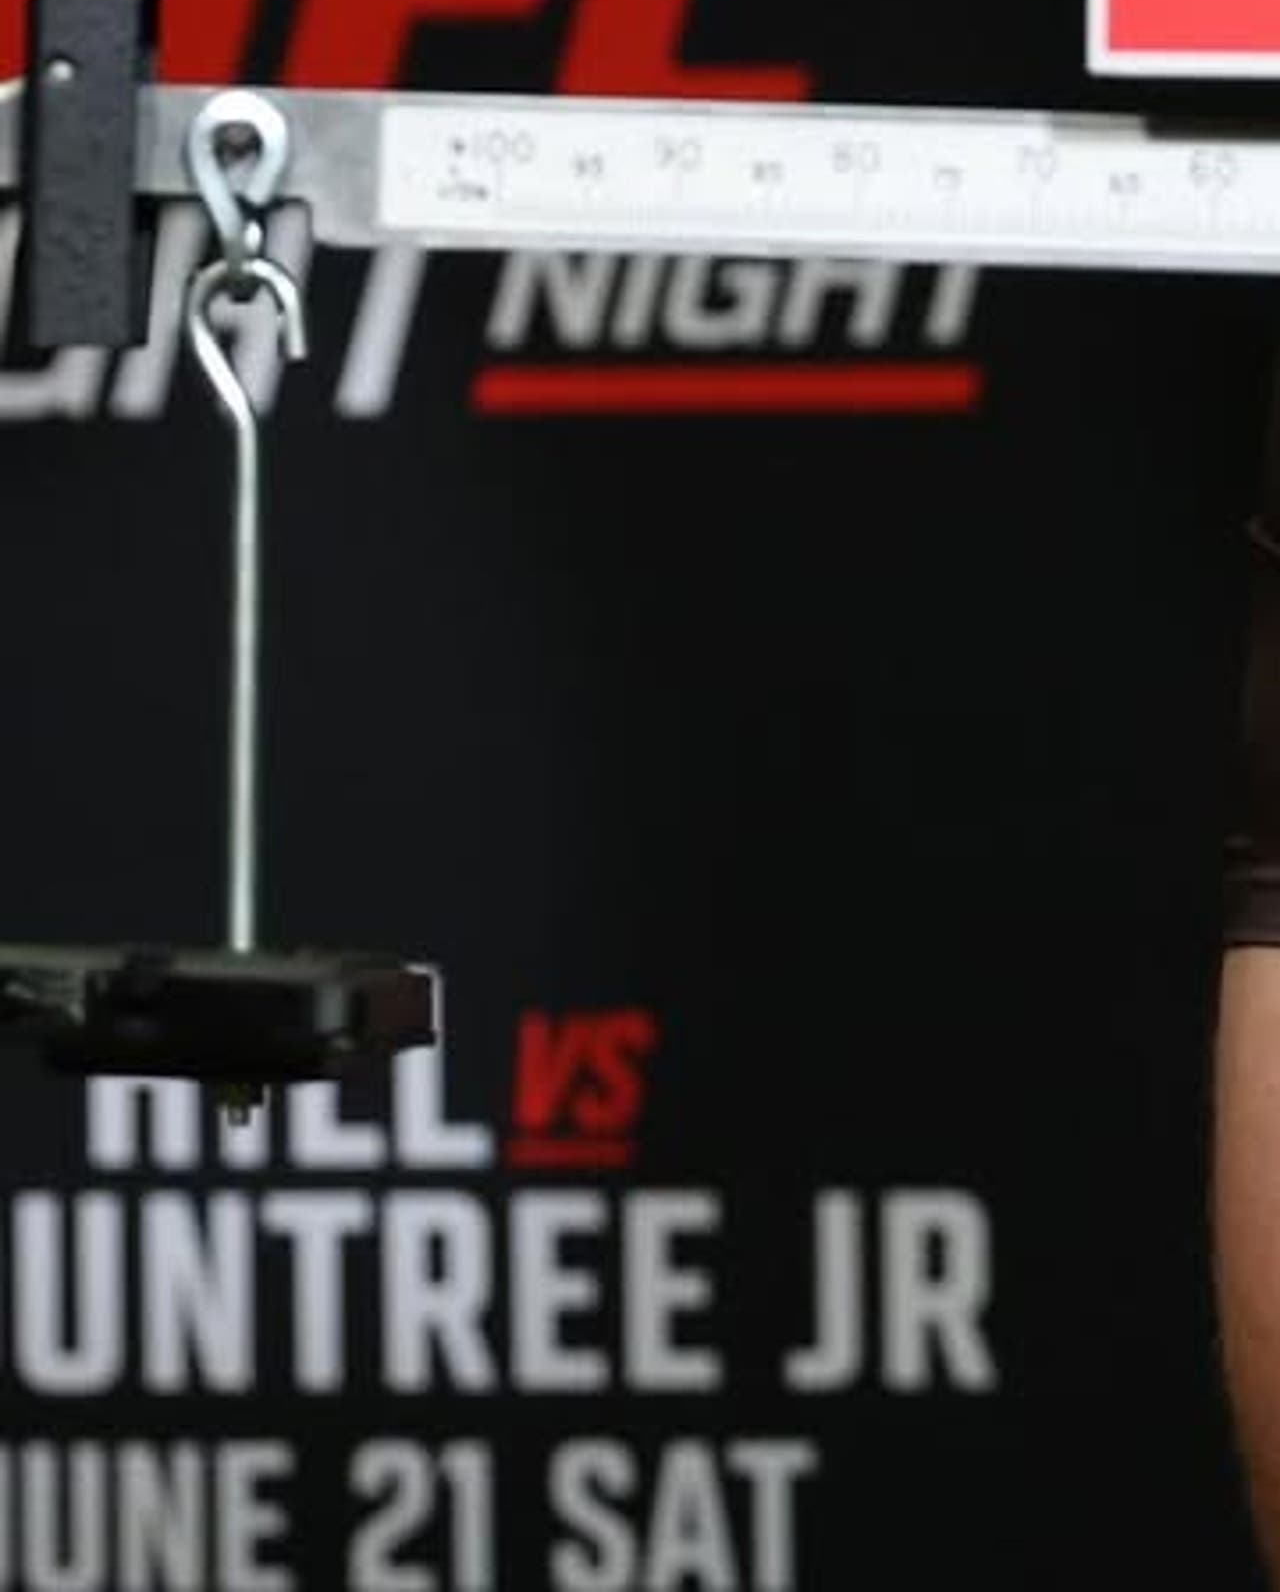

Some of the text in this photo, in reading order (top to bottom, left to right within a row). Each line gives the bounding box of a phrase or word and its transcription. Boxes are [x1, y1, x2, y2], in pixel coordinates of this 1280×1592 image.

[510, 1009, 663, 1131] VS
[8, 1185, 997, 1396] UNTREE JR
[346, 1438, 499, 1592] 21
[547, 1437, 819, 1592] SAT
